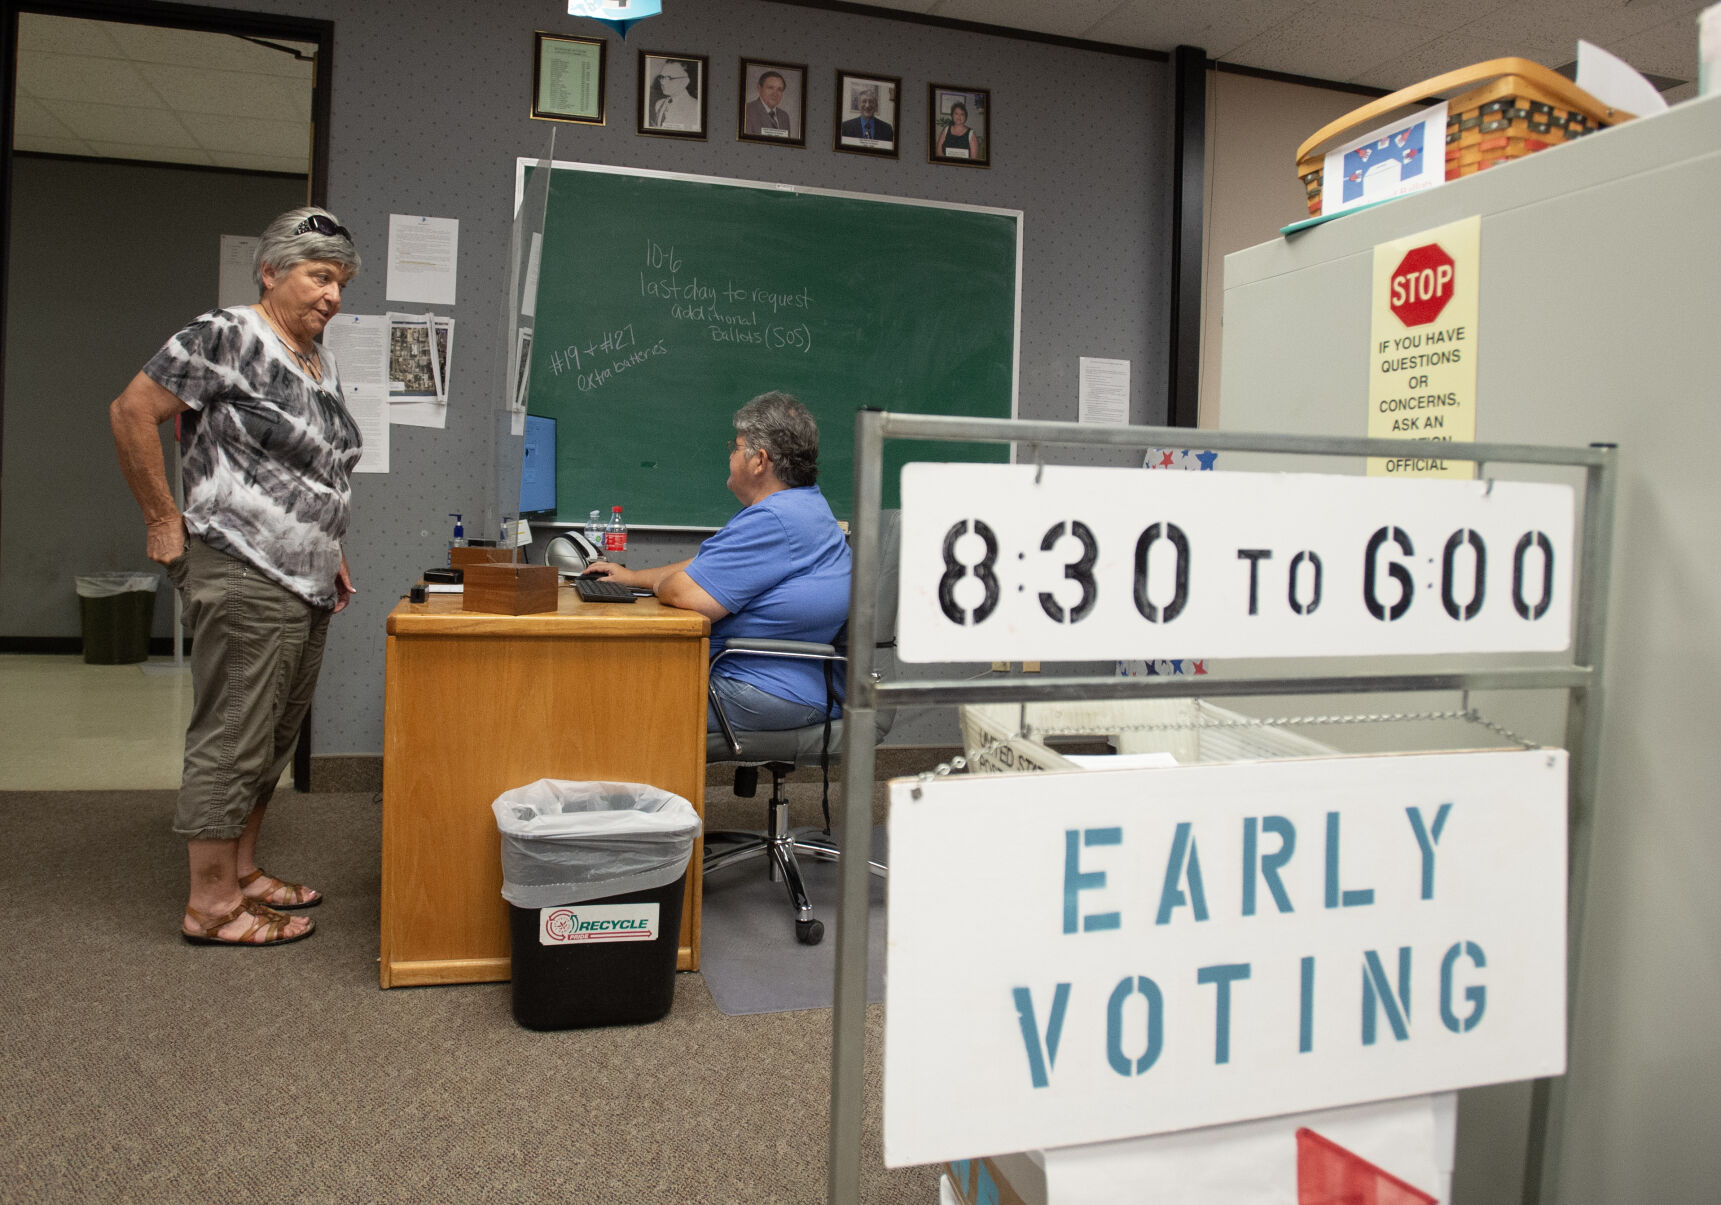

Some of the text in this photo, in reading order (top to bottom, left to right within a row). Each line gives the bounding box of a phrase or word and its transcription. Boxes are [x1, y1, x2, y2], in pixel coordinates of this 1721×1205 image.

[647, 239, 682, 272] 10-6
[640, 272, 814, 313] last day to request
[1392, 264, 1452, 306] STOP
[671, 303, 757, 326] additional
[708, 325, 762, 344] Ballots
[1379, 327, 1465, 354] IF YOU HAVE
[549, 345, 581, 376] #19
[600, 323, 635, 353] #27
[1381, 349, 1461, 373] QUESTIONS
[1408, 375, 1428, 389] OR
[1379, 392, 1460, 413] CONCERNS,
[1392, 415, 1444, 432] ASK AN
[1386, 459, 1448, 472] OFFICIAL
[938, 518, 1555, 626] 8:30 TO 6:00
[1062, 803, 1454, 936] EARLY
[579, 918, 648, 932] RECYCLE
[1012, 940, 1488, 1089] VOTING
